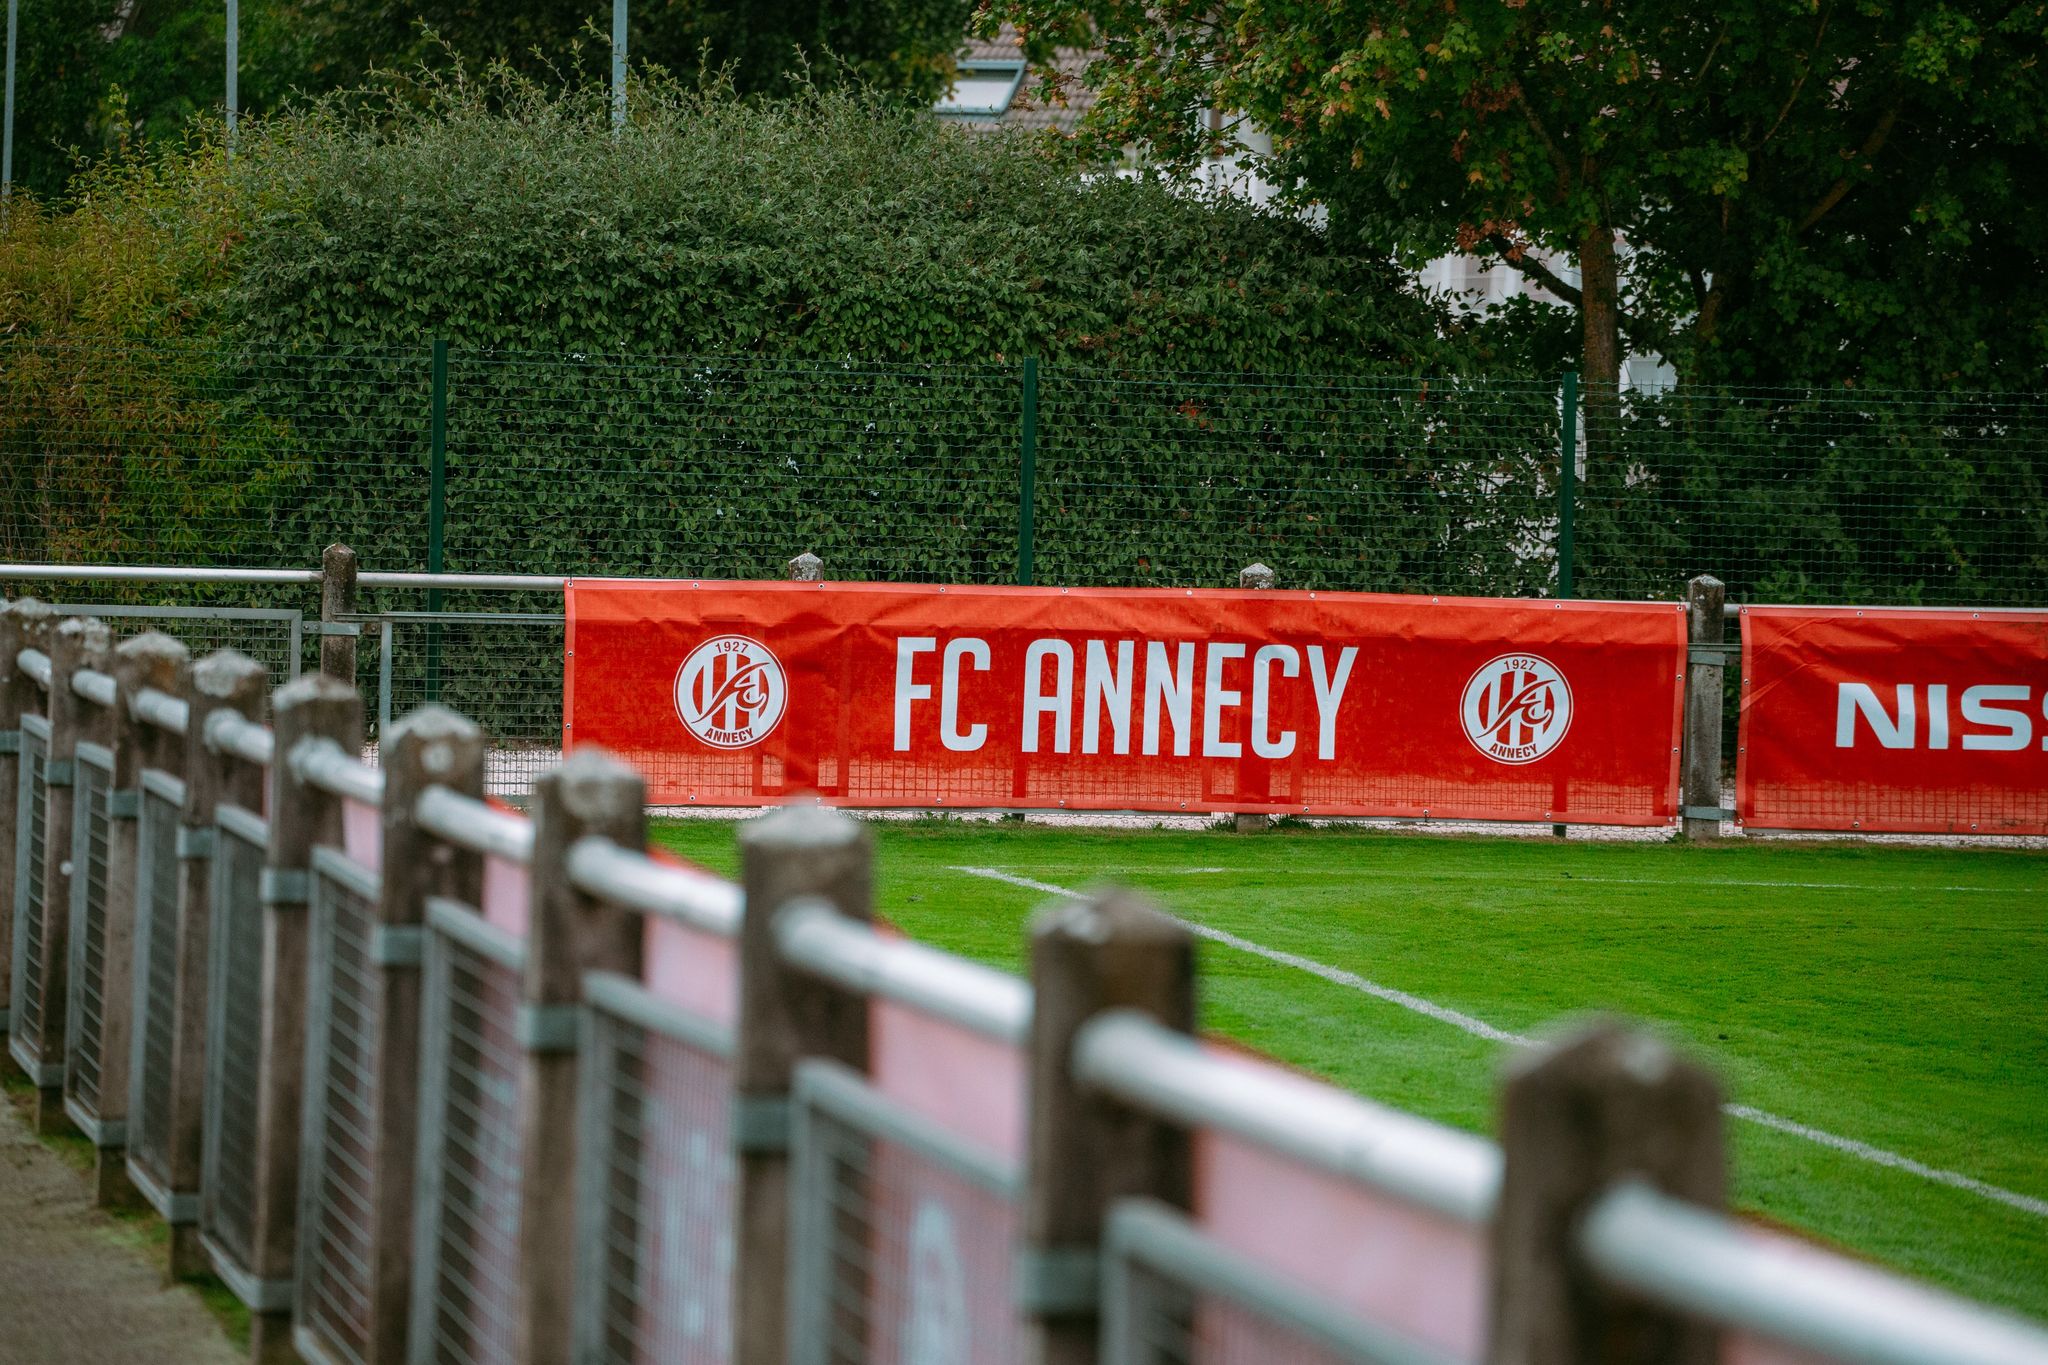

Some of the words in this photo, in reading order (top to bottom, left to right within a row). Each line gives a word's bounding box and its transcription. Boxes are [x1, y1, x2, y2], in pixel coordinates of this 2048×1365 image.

[715, 642, 748, 653] 1927
[1504, 660, 1536, 670] 1927
[893, 636, 991, 752] FC
[1021, 638, 1359, 760] ANNECY
[1835, 682, 2048, 751] NIS
[705, 728, 753, 743] ANNECY
[1490, 744, 1537, 758] ANNECY
